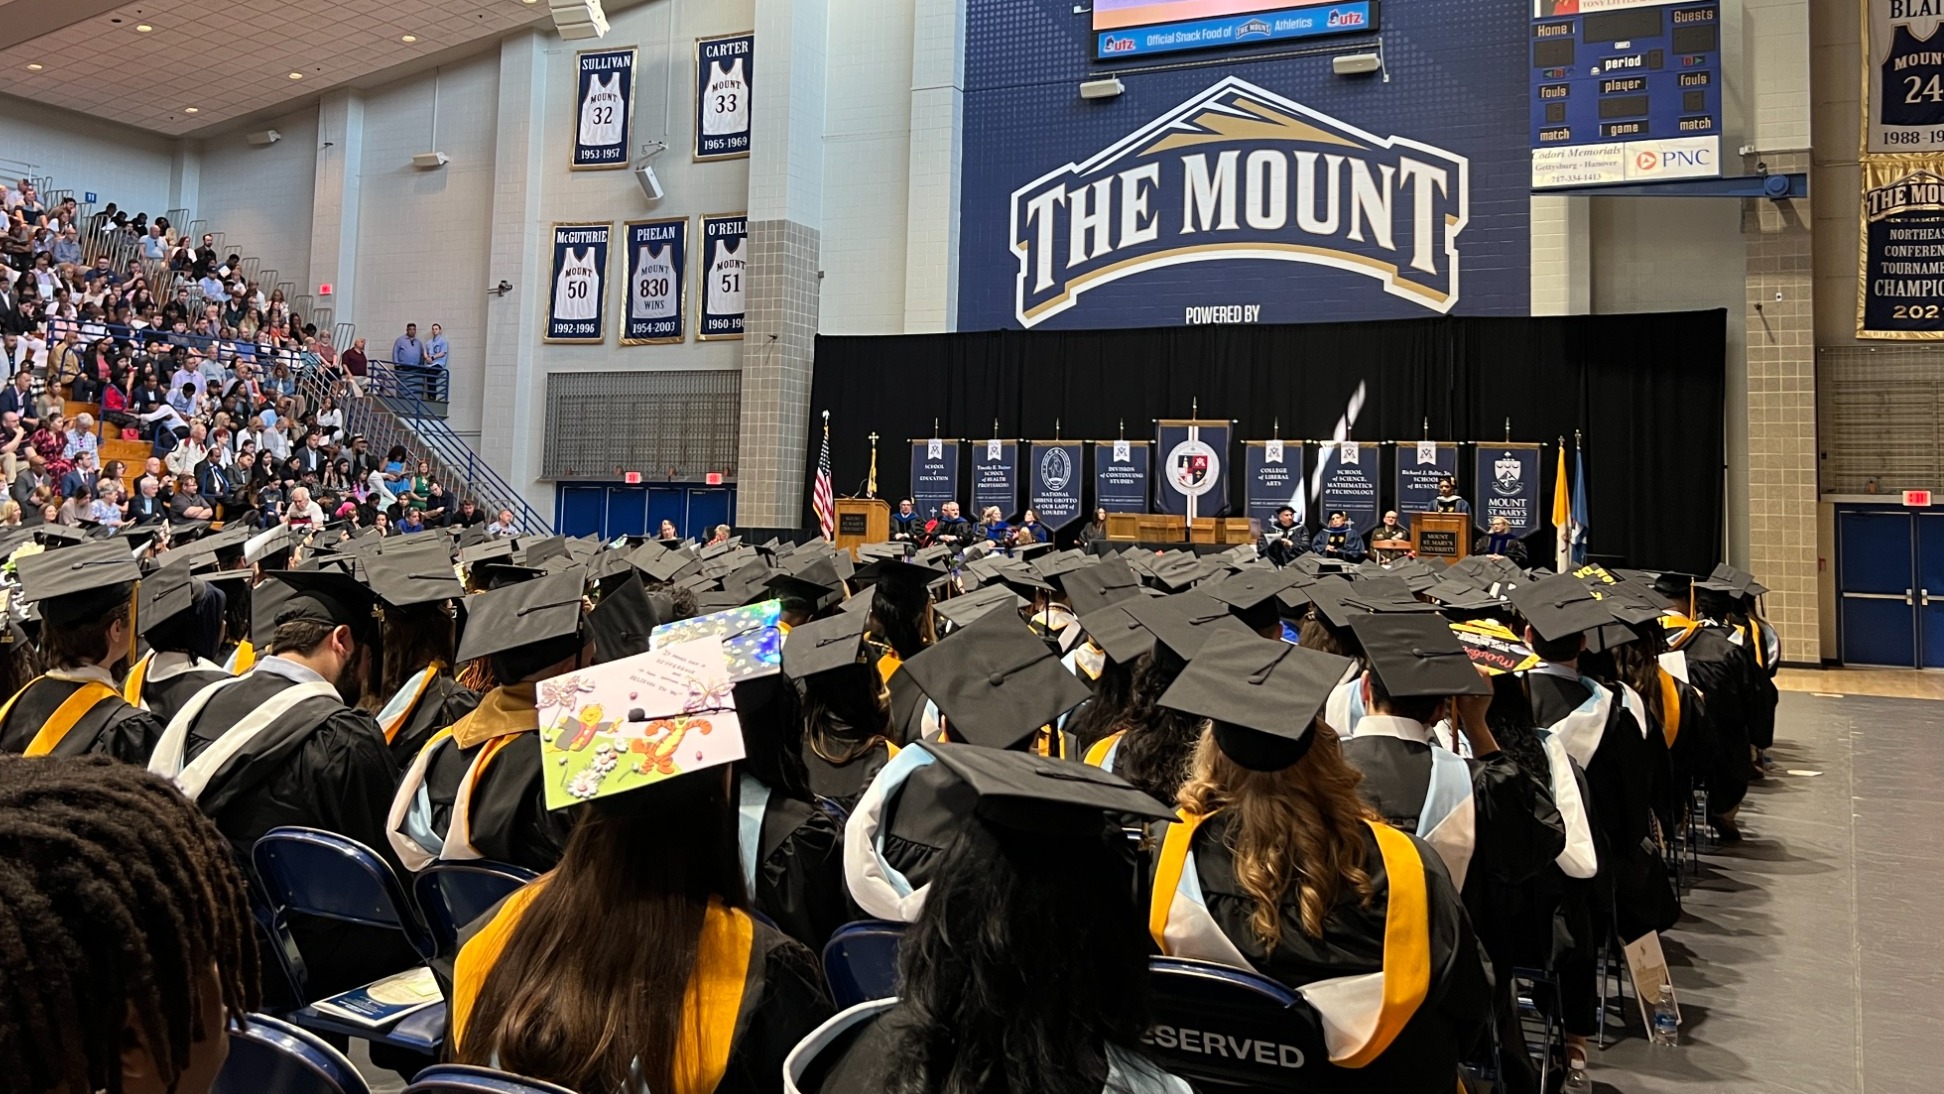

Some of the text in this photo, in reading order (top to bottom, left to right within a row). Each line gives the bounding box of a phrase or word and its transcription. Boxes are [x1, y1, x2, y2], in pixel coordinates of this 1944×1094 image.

[1674, 10, 1713, 23] Guests
[1147, 34, 1175, 46] Official
[1176, 30, 1201, 43] Snack
[1202, 27, 1222, 40] Food
[1223, 26, 1232, 37] of
[1275, 18, 1312, 31] Athletics
[1537, 24, 1568, 37] Home
[706, 41, 749, 58] CARTER
[582, 55, 631, 70] SULLIVAN
[1605, 55, 1642, 71] period
[1894, 52, 1944, 71] MOUN
[712, 80, 742, 92] MOUNT
[1605, 79, 1641, 93] player
[1680, 73, 1707, 86] fouls
[1541, 86, 1566, 98] fouls
[1903, 74, 1944, 104] 24
[590, 92, 617, 104] MOUNT
[715, 93, 737, 113] 33
[593, 106, 613, 125] 32
[1611, 123, 1638, 136] game
[1679, 118, 1711, 131] match
[1540, 129, 1570, 141] match
[704, 136, 748, 150] 1965-1969
[581, 148, 620, 159] 1953-1957
[1567, 146, 1621, 158] Memorials
[1663, 149, 1711, 168] PNC
[1535, 162, 1578, 172] Gettysburg
[1869, 185, 1907, 214] THE
[1026, 149, 1448, 295] THE MOUNT
[556, 231, 607, 243] McGUTHRIE
[637, 226, 676, 242] PHELAN
[641, 264, 669, 276] MOUNT
[717, 259, 746, 272] MOUNT
[565, 267, 592, 278] MOUNT
[640, 278, 669, 298] 830
[722, 273, 740, 293] 51
[567, 281, 588, 299] 50
[644, 300, 664, 310] WINS
[1893, 304, 1944, 319] 202
[1185, 304, 1261, 324] POWERED BY
[554, 323, 595, 333] 1992-1996
[632, 321, 676, 333] 1954-2003
[1488, 498, 1527, 507] MOUNT
